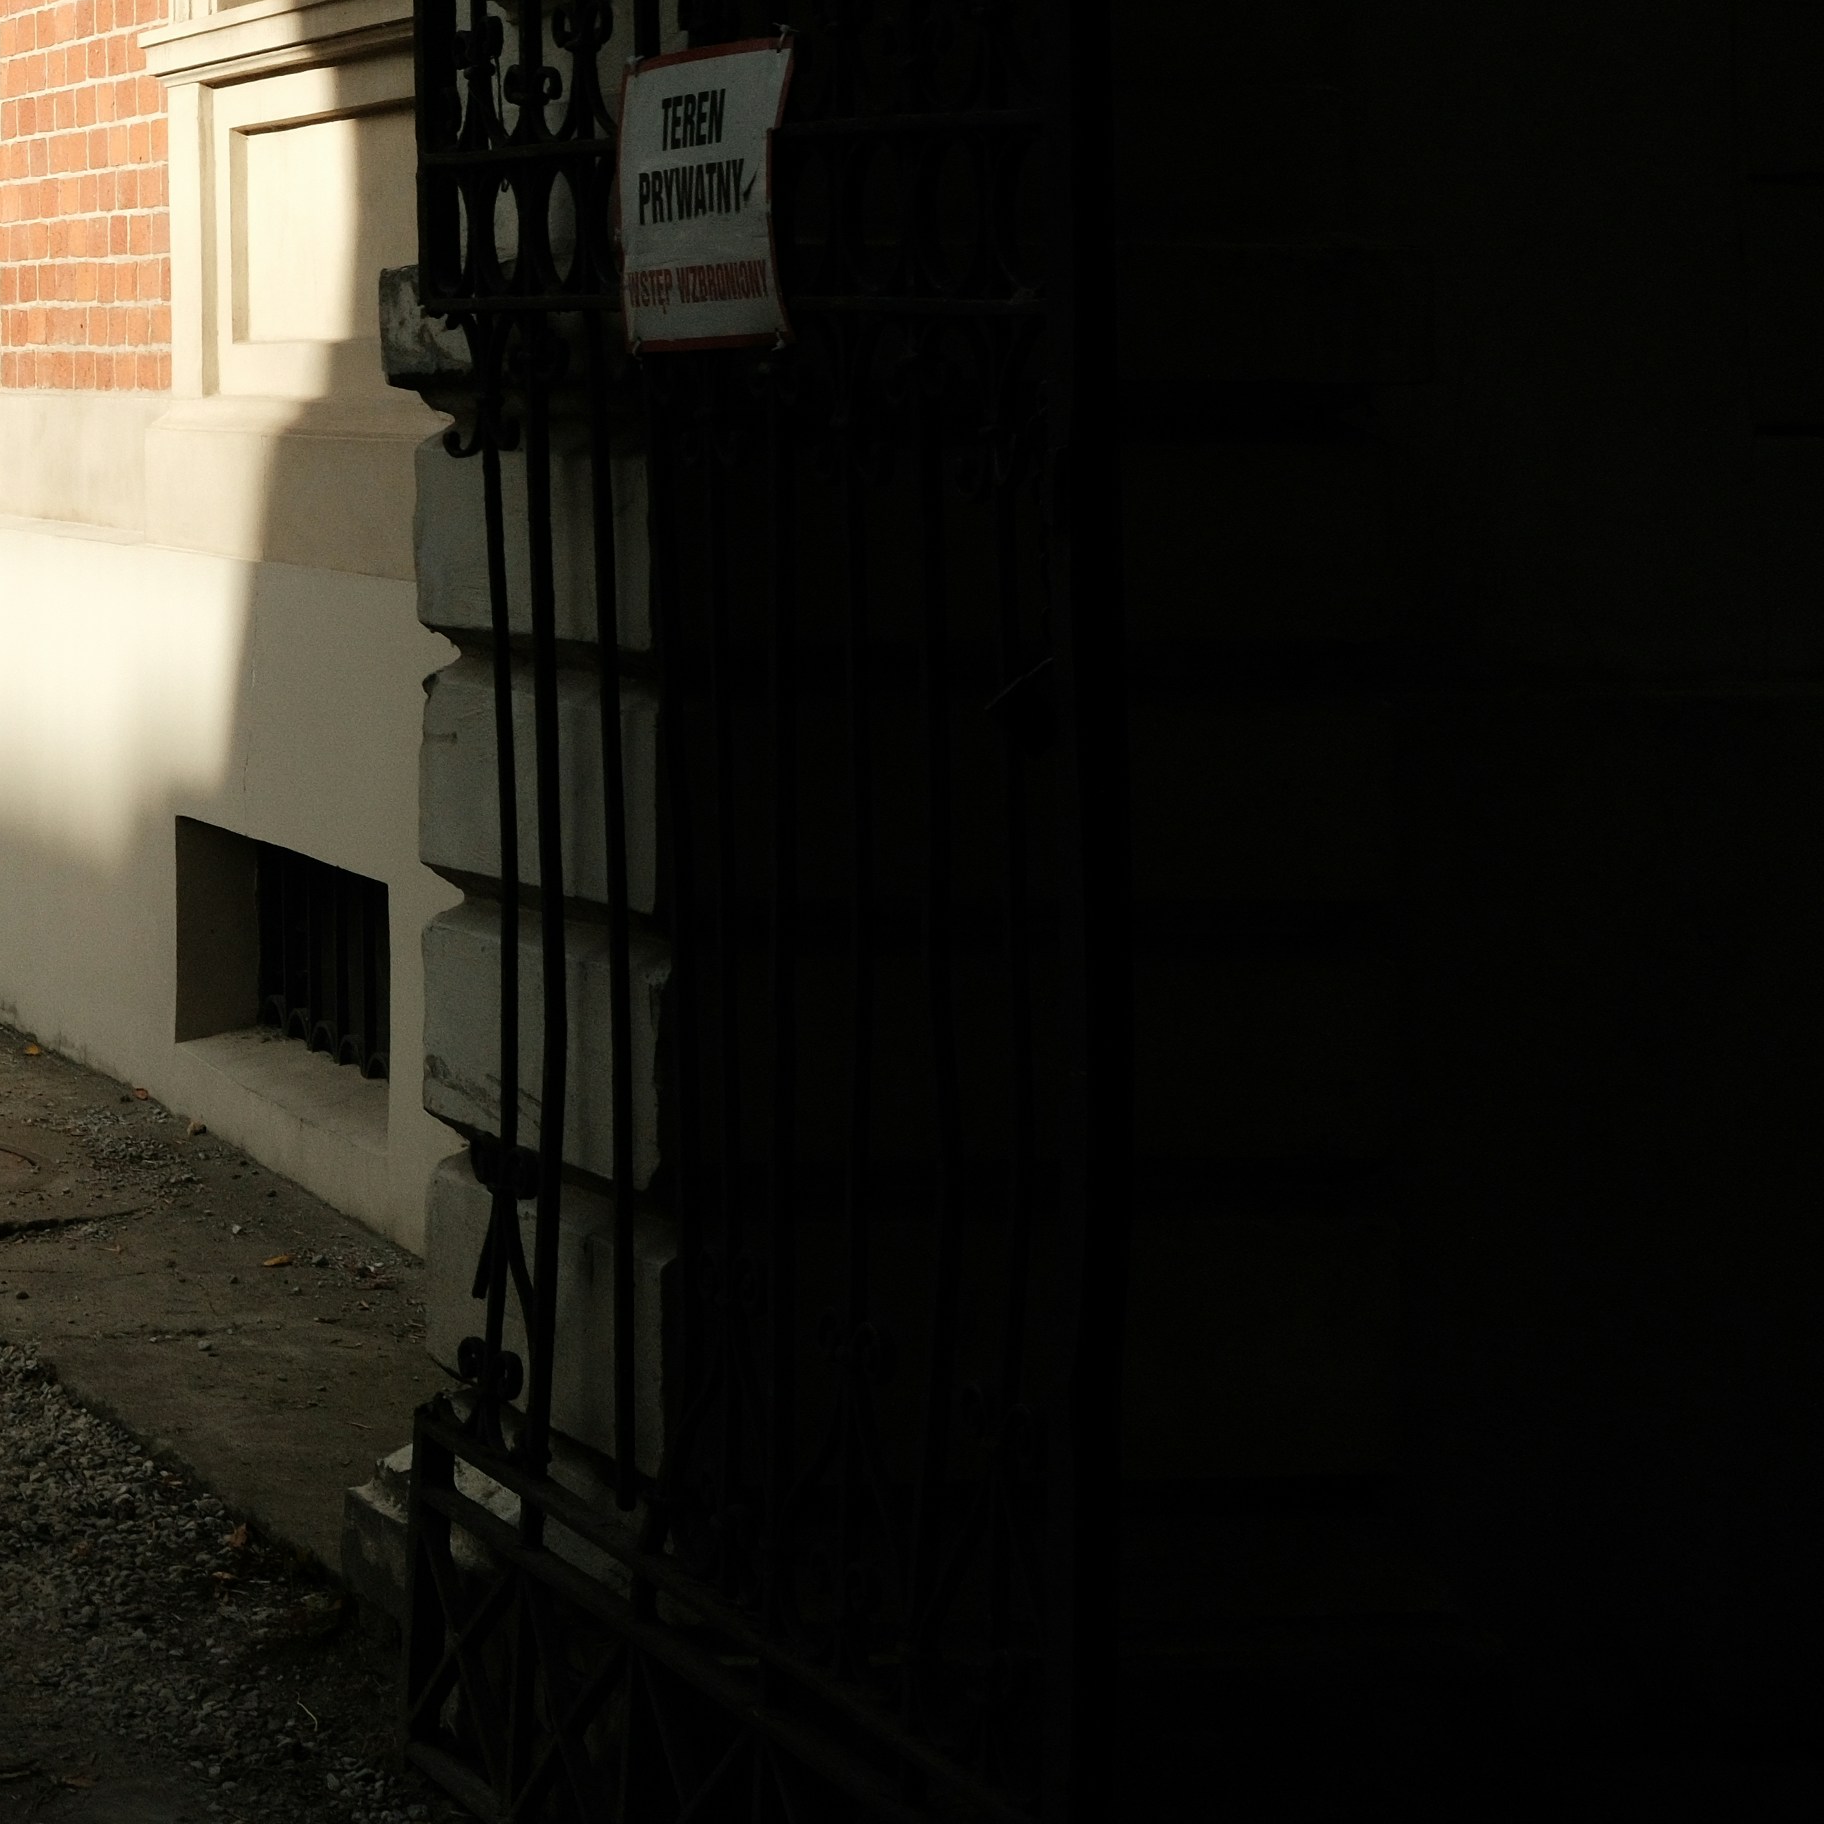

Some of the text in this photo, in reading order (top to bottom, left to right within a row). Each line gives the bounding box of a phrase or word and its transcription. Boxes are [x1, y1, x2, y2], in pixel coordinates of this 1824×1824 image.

[662, 88, 726, 151] TEREN
[639, 158, 745, 225] PRYWATNY
[628, 259, 768, 314] WSTĘP WZBRONIONY
